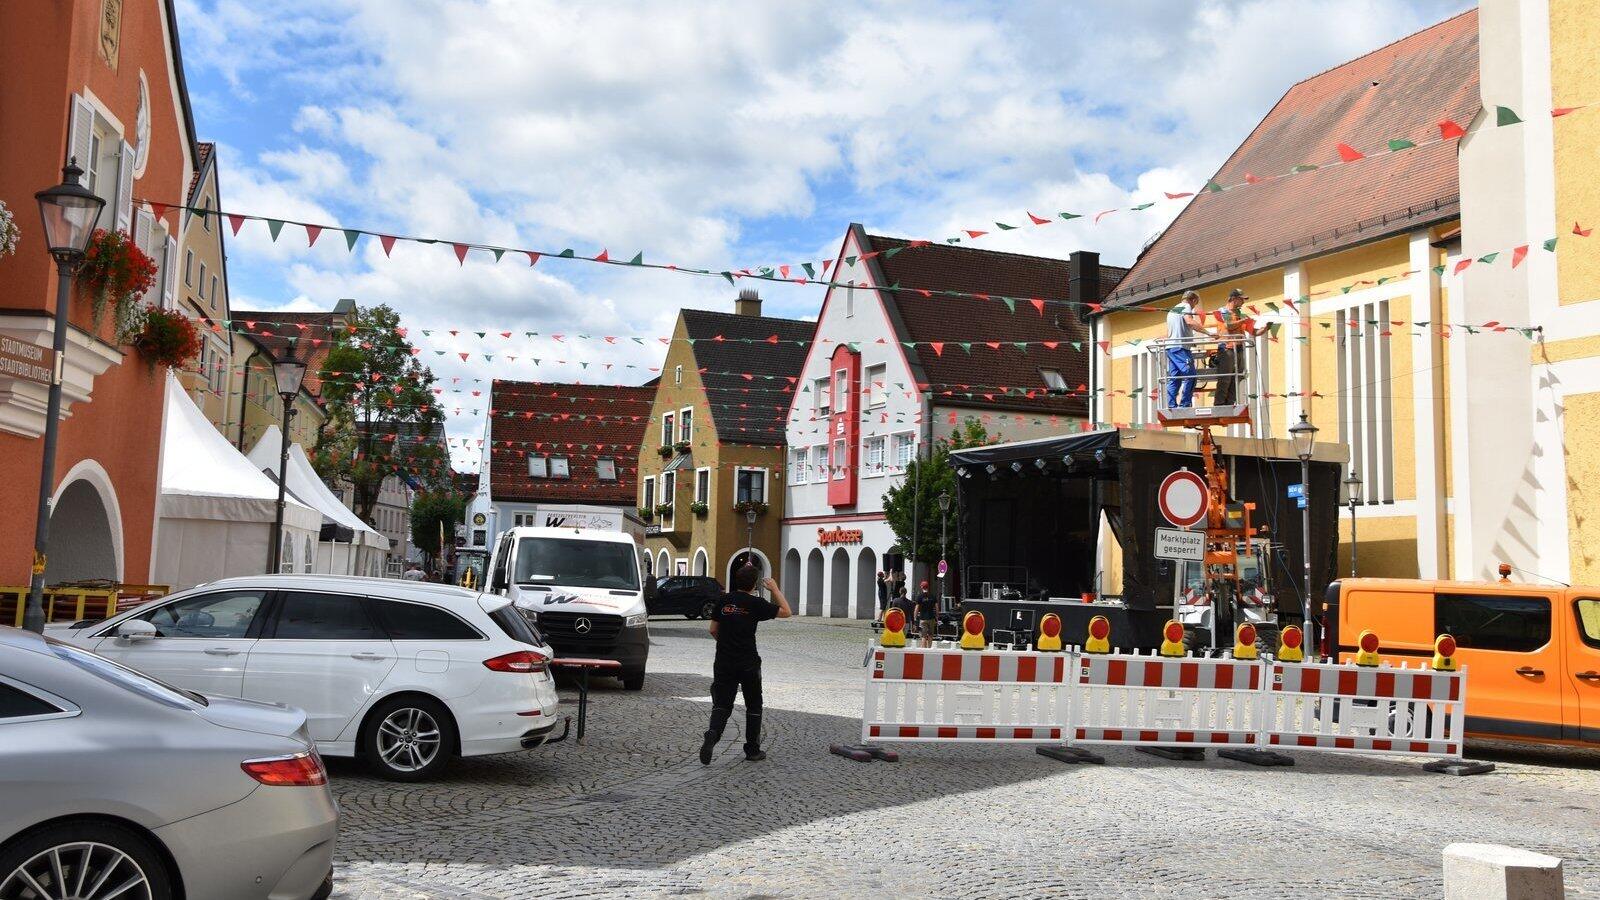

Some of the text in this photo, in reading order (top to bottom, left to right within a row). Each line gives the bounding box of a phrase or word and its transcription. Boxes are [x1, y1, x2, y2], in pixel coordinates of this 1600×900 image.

[2, 338, 43, 361] STADTMUSEUM
[0, 357, 53, 383] STADTBIBLIOTHEK
[817, 526, 863, 546] Sparkasse
[1160, 533, 1201, 545] Marktplatz
[1163, 546, 1197, 555] gesperrt
